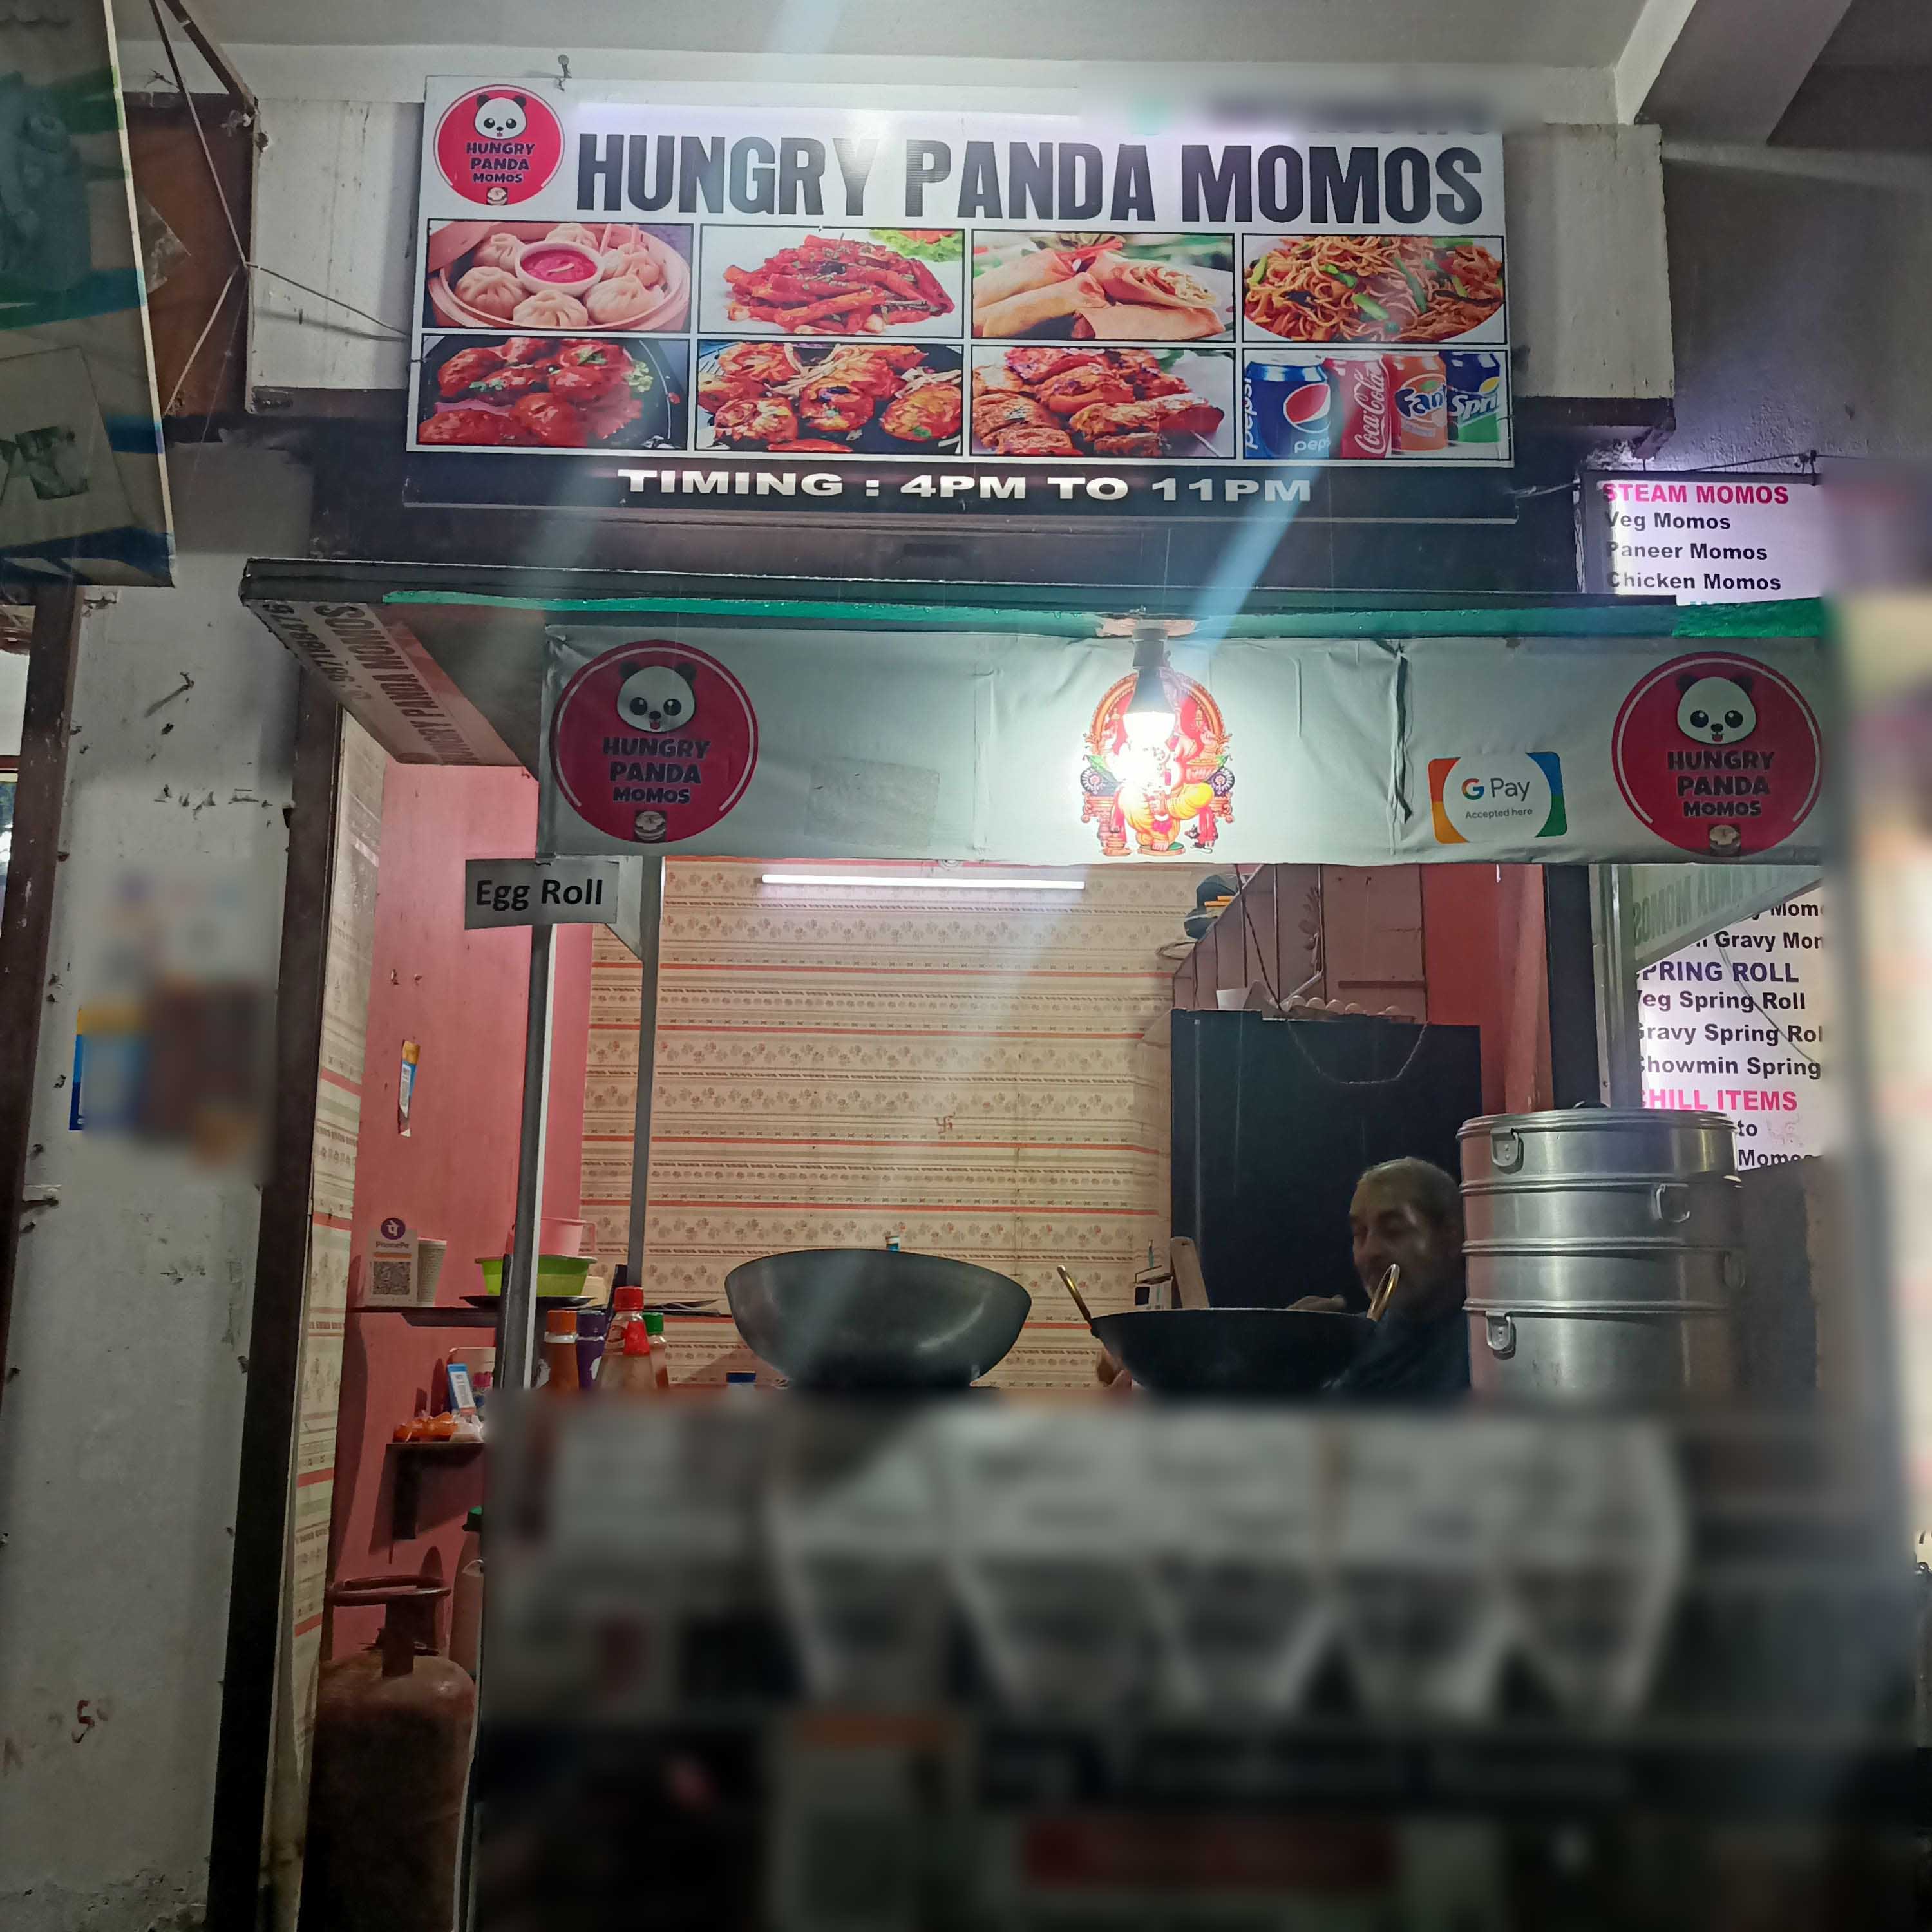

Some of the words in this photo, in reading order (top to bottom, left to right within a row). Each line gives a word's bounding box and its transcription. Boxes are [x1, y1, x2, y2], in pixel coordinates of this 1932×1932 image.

[466, 142, 535, 155] HUNGRY
[471, 158, 529, 170] PANDA
[473, 173, 522, 183] MOMOS
[577, 133, 878, 216] HUNGRY
[905, 140, 1156, 221] PANDA
[1182, 144, 1482, 225] MOMOS
[618, 469, 842, 496] TIMING
[866, 480, 880, 497] :
[900, 475, 1026, 499] 4PM
[1047, 477, 1128, 500] TO
[1152, 478, 1311, 502] 11PM
[1602, 484, 1687, 503] STEAM
[1696, 486, 1788, 504] MOMOS
[1604, 511, 1646, 531] Veg
[1654, 512, 1731, 529] Momos
[1606, 541, 1683, 559] Paneer
[1690, 543, 1768, 560] Momos
[1607, 571, 1696, 589] Chicken
[1703, 573, 1781, 591] Momos
[603, 737, 712, 759] HUNGRY
[1667, 750, 1775, 770] HUNGRY
[609, 761, 701, 784] PANDA
[613, 786, 690, 804] MOMOS
[1462, 777, 1484, 800] G
[1490, 777, 1530, 802] Pay
[1677, 775, 1771, 797] PANDA
[1466, 808, 1510, 819] Accepted
[1511, 808, 1533, 816] here
[1683, 801, 1763, 817] MOMOS
[476, 880, 530, 911] Egg
[541, 878, 603, 905] Roll
[1771, 900, 1824, 917] Mom
[1715, 931, 1776, 952] Gravy
[1638, 961, 1723, 981] PRING
[1733, 963, 1799, 982] ROLL
[1680, 990, 1754, 1013] Spring
[1763, 992, 1805, 1009] Roll
[1705, 1023, 1779, 1046] Spring
[1747, 1057, 1821, 1080] Spring
[1717, 1090, 1798, 1111] ITEMS
